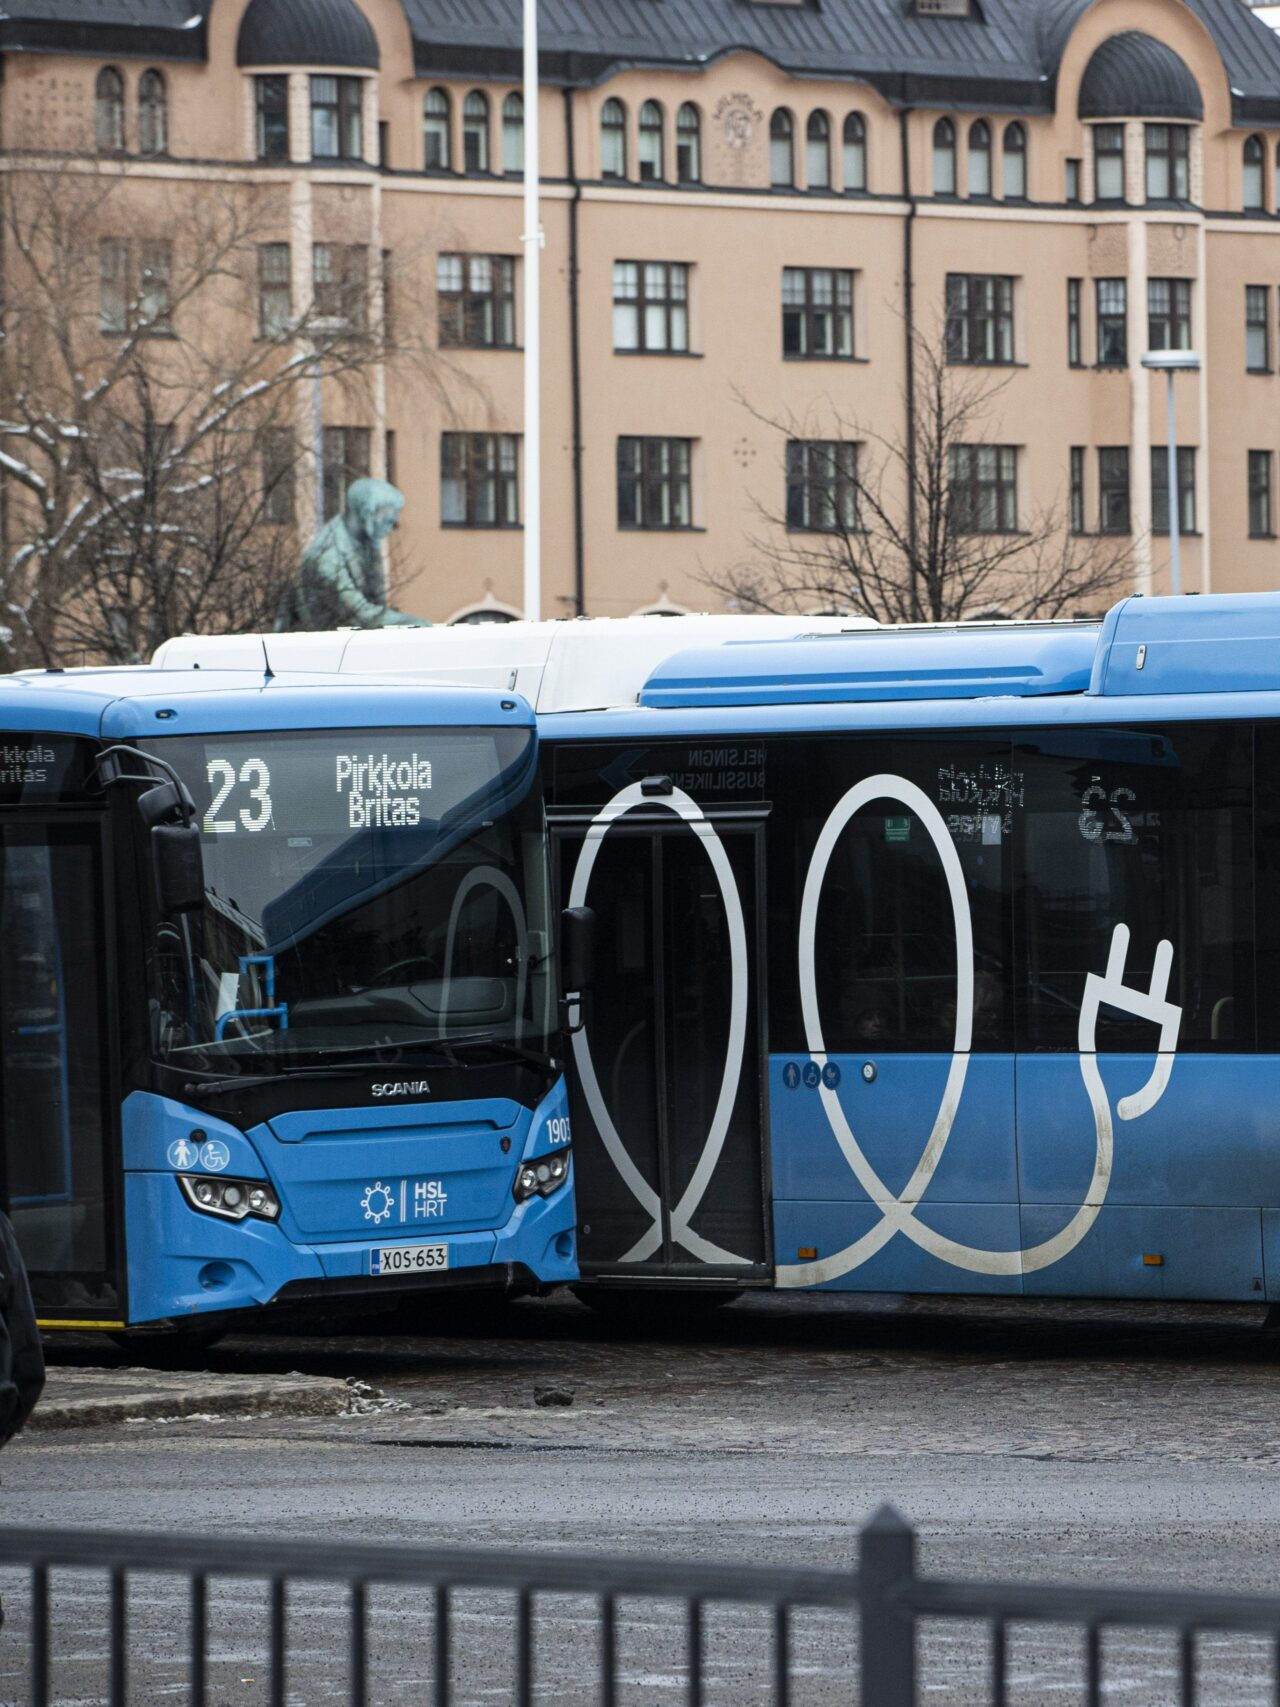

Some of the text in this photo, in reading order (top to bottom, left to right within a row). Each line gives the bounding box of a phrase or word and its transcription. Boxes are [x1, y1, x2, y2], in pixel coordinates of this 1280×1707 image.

[336, 753, 432, 792] Pirkkola
[203, 758, 272, 832] 23
[349, 790, 420, 828] Britas
[371, 1080, 431, 1097] SCANIA
[414, 1181, 447, 1200] HSL
[414, 1199, 448, 1218] HRT
[383, 1247, 445, 1270] XOS-653
